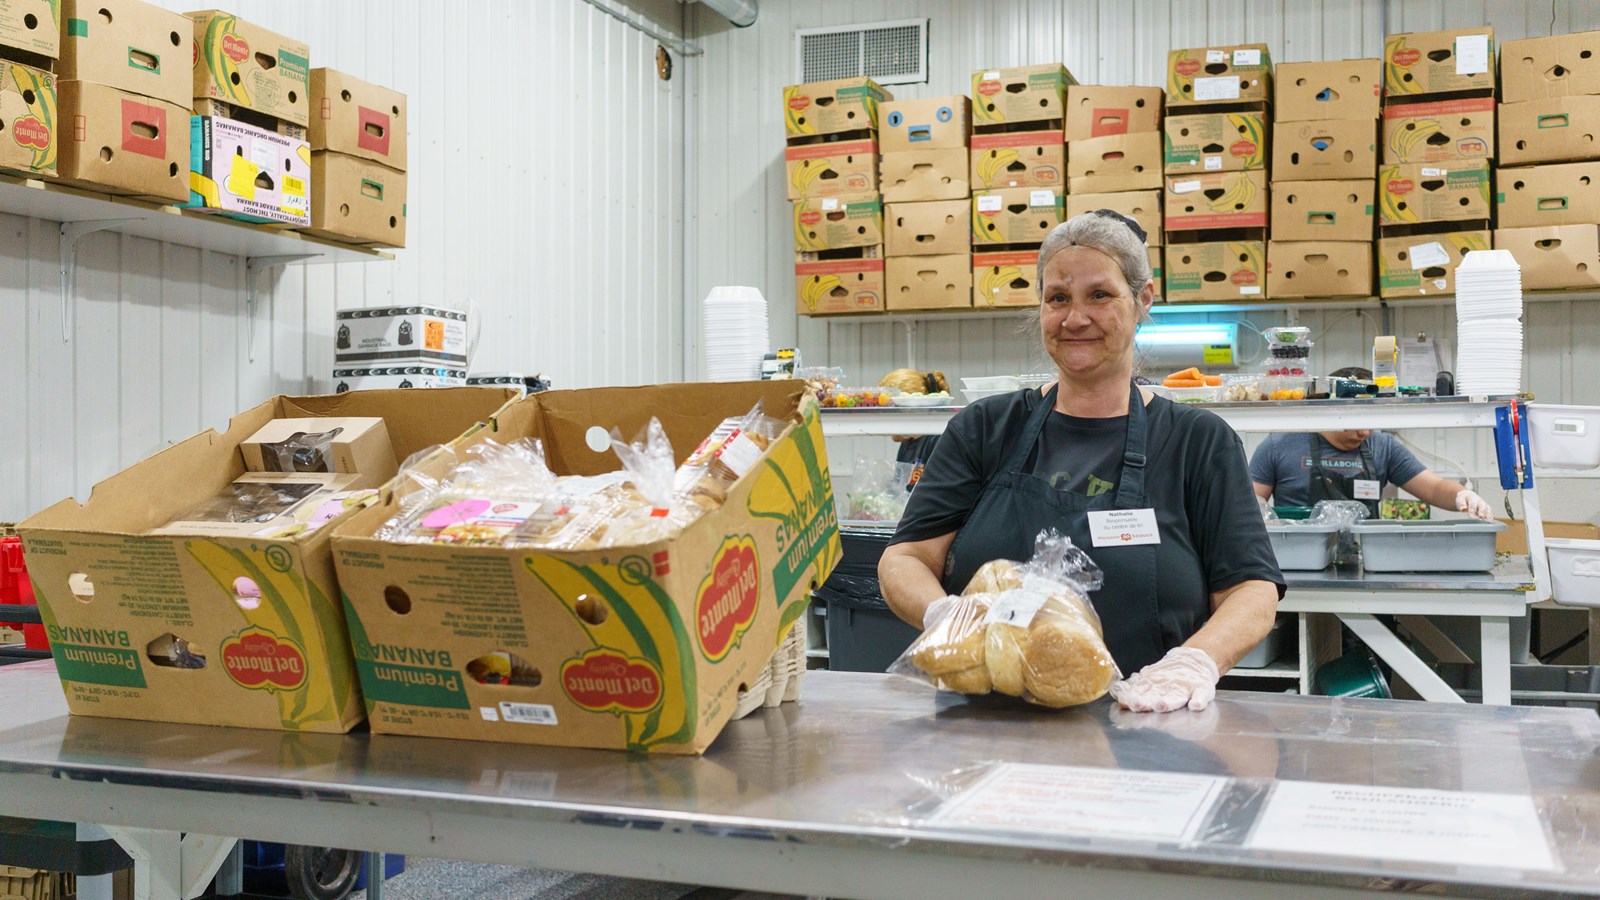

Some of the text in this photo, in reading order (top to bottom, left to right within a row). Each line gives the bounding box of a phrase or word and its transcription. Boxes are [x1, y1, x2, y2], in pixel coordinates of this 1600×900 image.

[232, 42, 249, 54] Monte
[279, 58, 306, 73] Premium
[15, 126, 48, 142] Del Monte
[216, 121, 290, 146] PREMIUM ORGANIC BANANAS
[236, 198, 258, 207] BANANA
[243, 206, 257, 214] MOST
[1320, 460, 1363, 468] ILLABONG
[775, 466, 831, 553] BANANAS
[787, 506, 837, 574] Premium
[740, 562, 756, 599] Del
[700, 585, 741, 638] Monte
[48, 625, 130, 647] BANANAS
[65, 648, 136, 670] Premium
[227, 655, 301, 673] Del Monte
[360, 643, 453, 667] BANANAS
[374, 666, 459, 691] Premium
[568, 677, 655, 694] Del Monte
